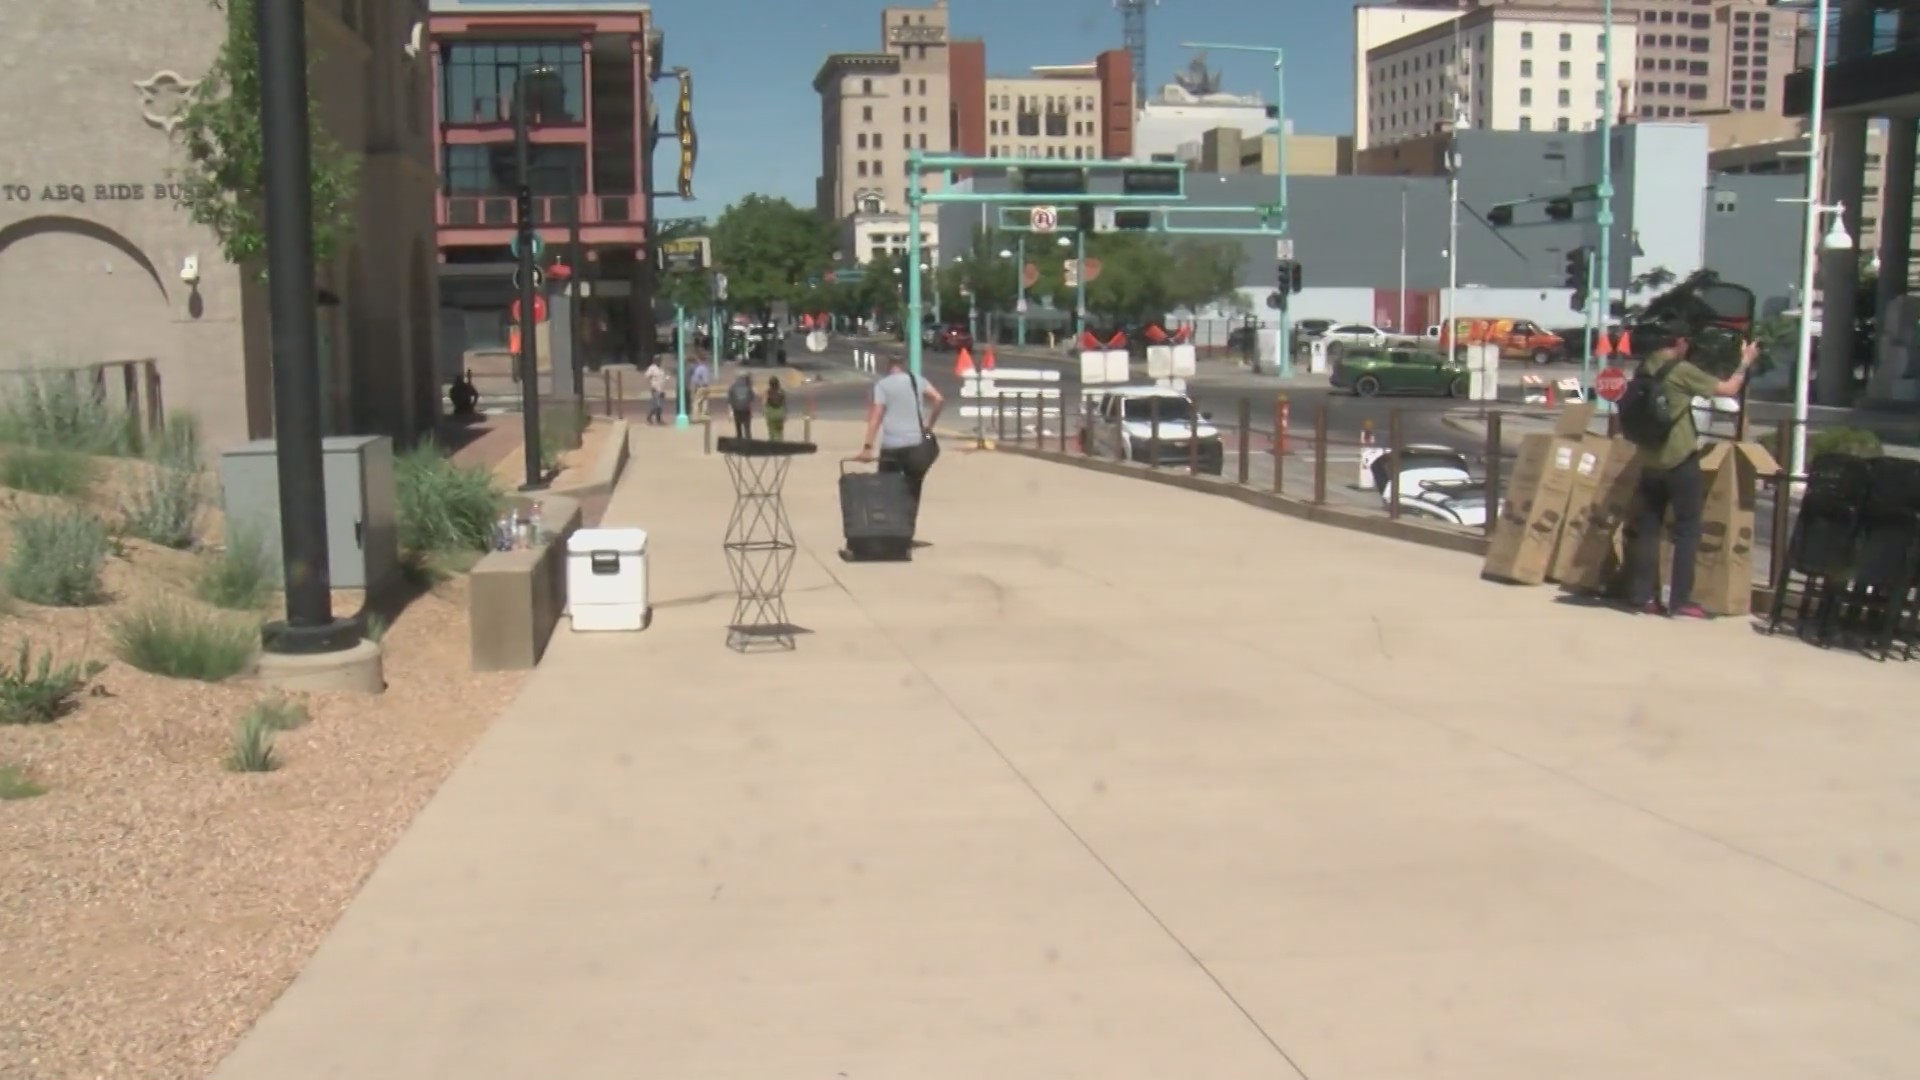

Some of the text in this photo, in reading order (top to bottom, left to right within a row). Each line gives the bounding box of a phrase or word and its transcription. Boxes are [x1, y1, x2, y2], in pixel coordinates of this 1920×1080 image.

[3, 184, 31, 201] TO
[41, 184, 86, 203] ABQ
[94, 183, 145, 200] RIDE
[1598, 377, 1624, 390] STOP
